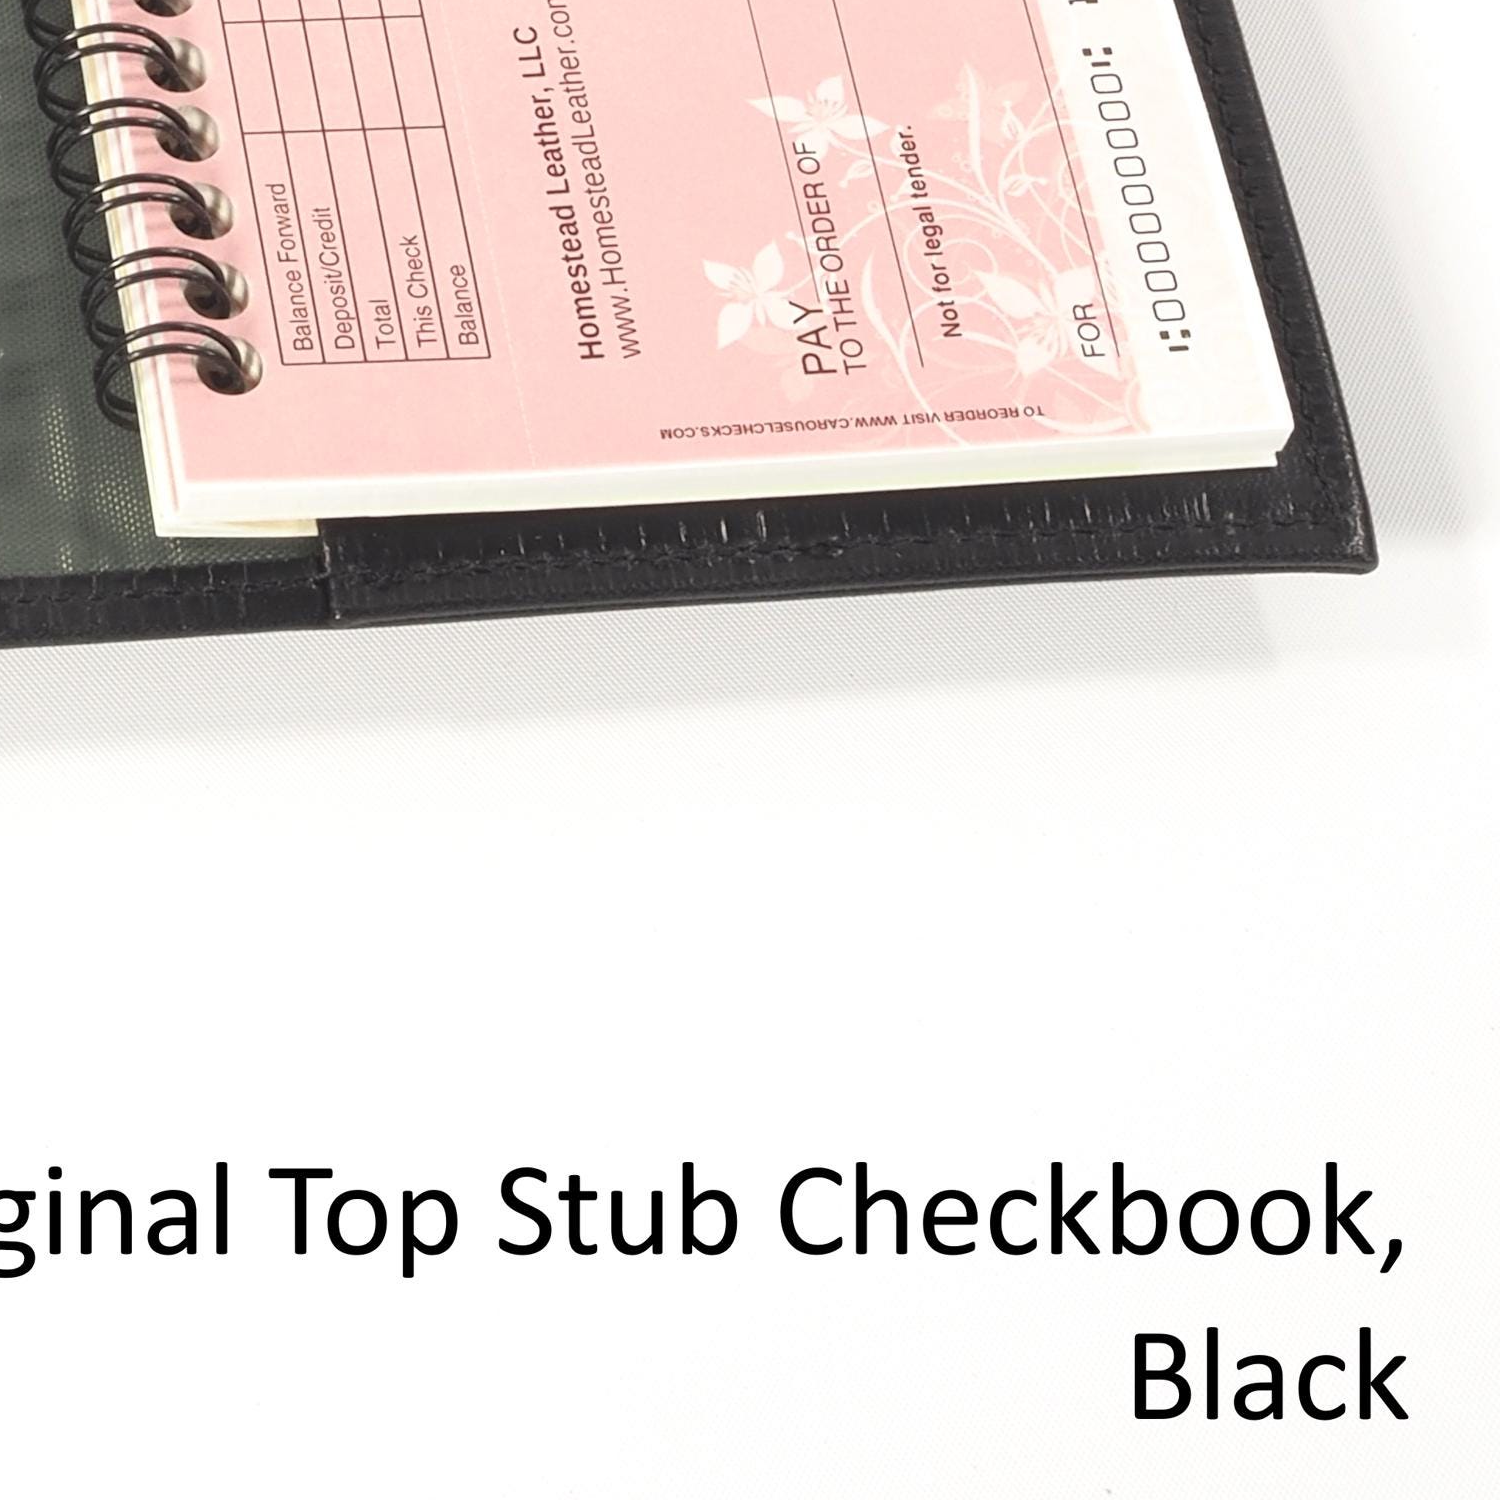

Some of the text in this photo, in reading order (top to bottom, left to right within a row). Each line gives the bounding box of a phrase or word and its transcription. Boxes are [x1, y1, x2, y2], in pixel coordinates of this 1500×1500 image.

[513, 25, 605, 360] Homestead Leather, LLC
[898, 124, 962, 338] Not for legal tender.
[265, 183, 314, 351] Balance Forward
[313, 206, 356, 350] Deposit/Credit
[400, 234, 437, 348] This Check
[450, 264, 479, 345] Balance
[793, 141, 867, 376] TO THE ORDER OF
[368, 299, 396, 349] Total
[788, 300, 837, 376] PAY
[1073, 303, 1106, 358] FOR
[660, 405, 1045, 440] TO REORDER VISIT WWW.CAROUSELCHECKS.COM
